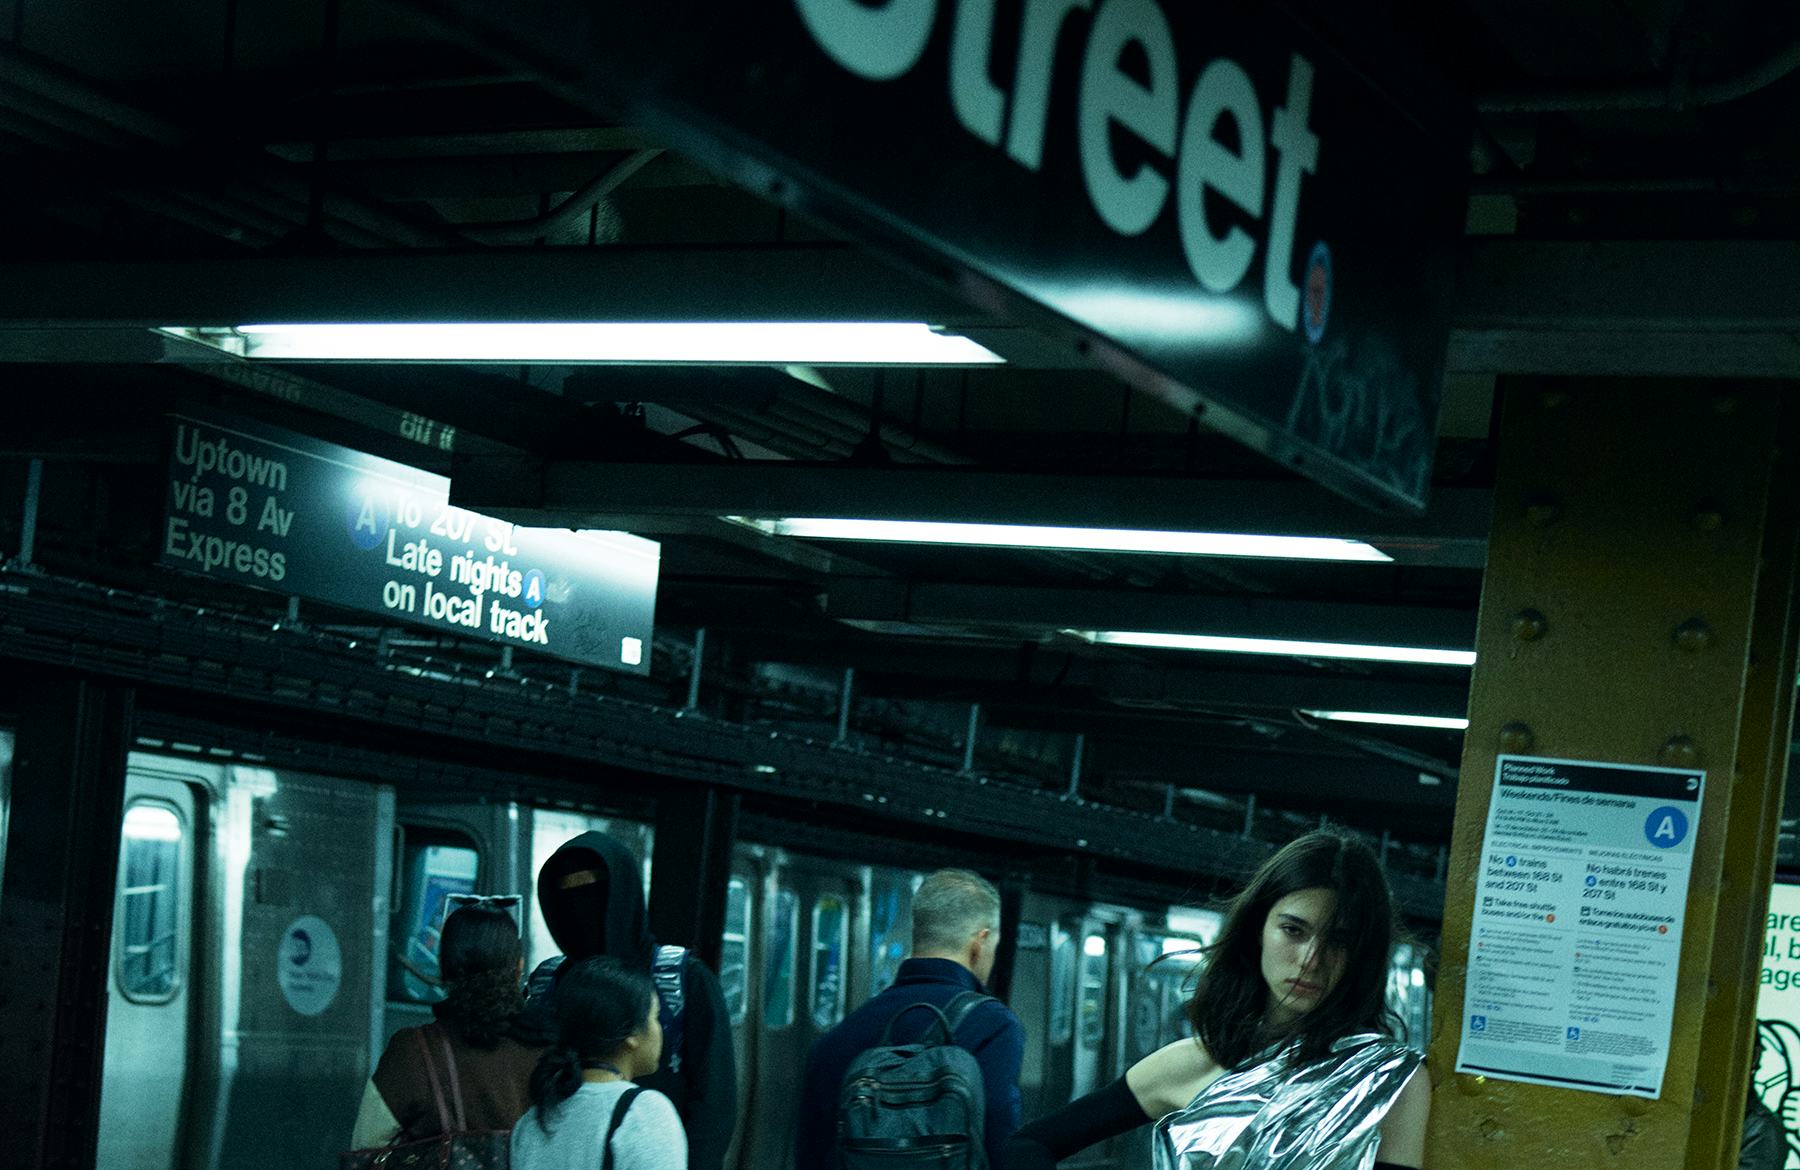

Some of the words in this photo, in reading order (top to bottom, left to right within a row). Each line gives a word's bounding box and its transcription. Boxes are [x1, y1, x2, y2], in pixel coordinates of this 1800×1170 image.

[175, 424, 288, 491] Uptown
[173, 475, 215, 518] via
[226, 486, 249, 526] 8
[257, 495, 296, 537] Av
[354, 495, 378, 535] A
[165, 516, 287, 582] Express
[385, 528, 443, 577] Late
[449, 550, 523, 596] nights
[526, 574, 542, 603] A
[383, 580, 416, 613] on
[423, 580, 484, 629] local
[489, 599, 549, 645] track
[1651, 813, 1678, 841] A
[1489, 854, 1504, 865] No
[1586, 863, 1601, 874] No
